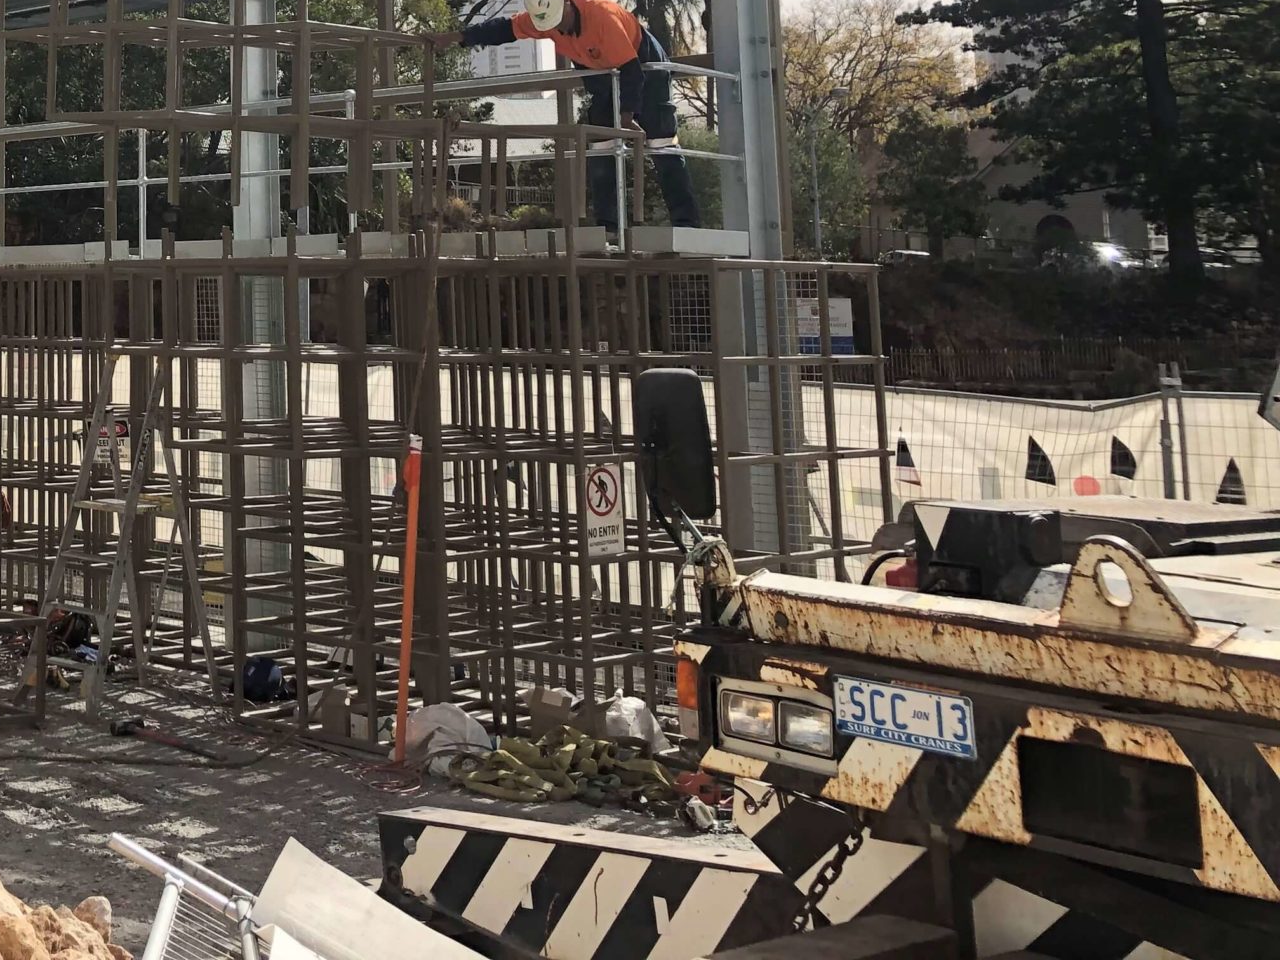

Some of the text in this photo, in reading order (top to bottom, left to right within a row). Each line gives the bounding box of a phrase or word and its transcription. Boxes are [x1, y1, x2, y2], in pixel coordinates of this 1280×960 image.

[588, 524, 619, 538] NO ENTRY
[849, 685, 908, 730] SCC
[935, 699, 969, 741] 13
[847, 722, 962, 752] SURF CITY CRANES
